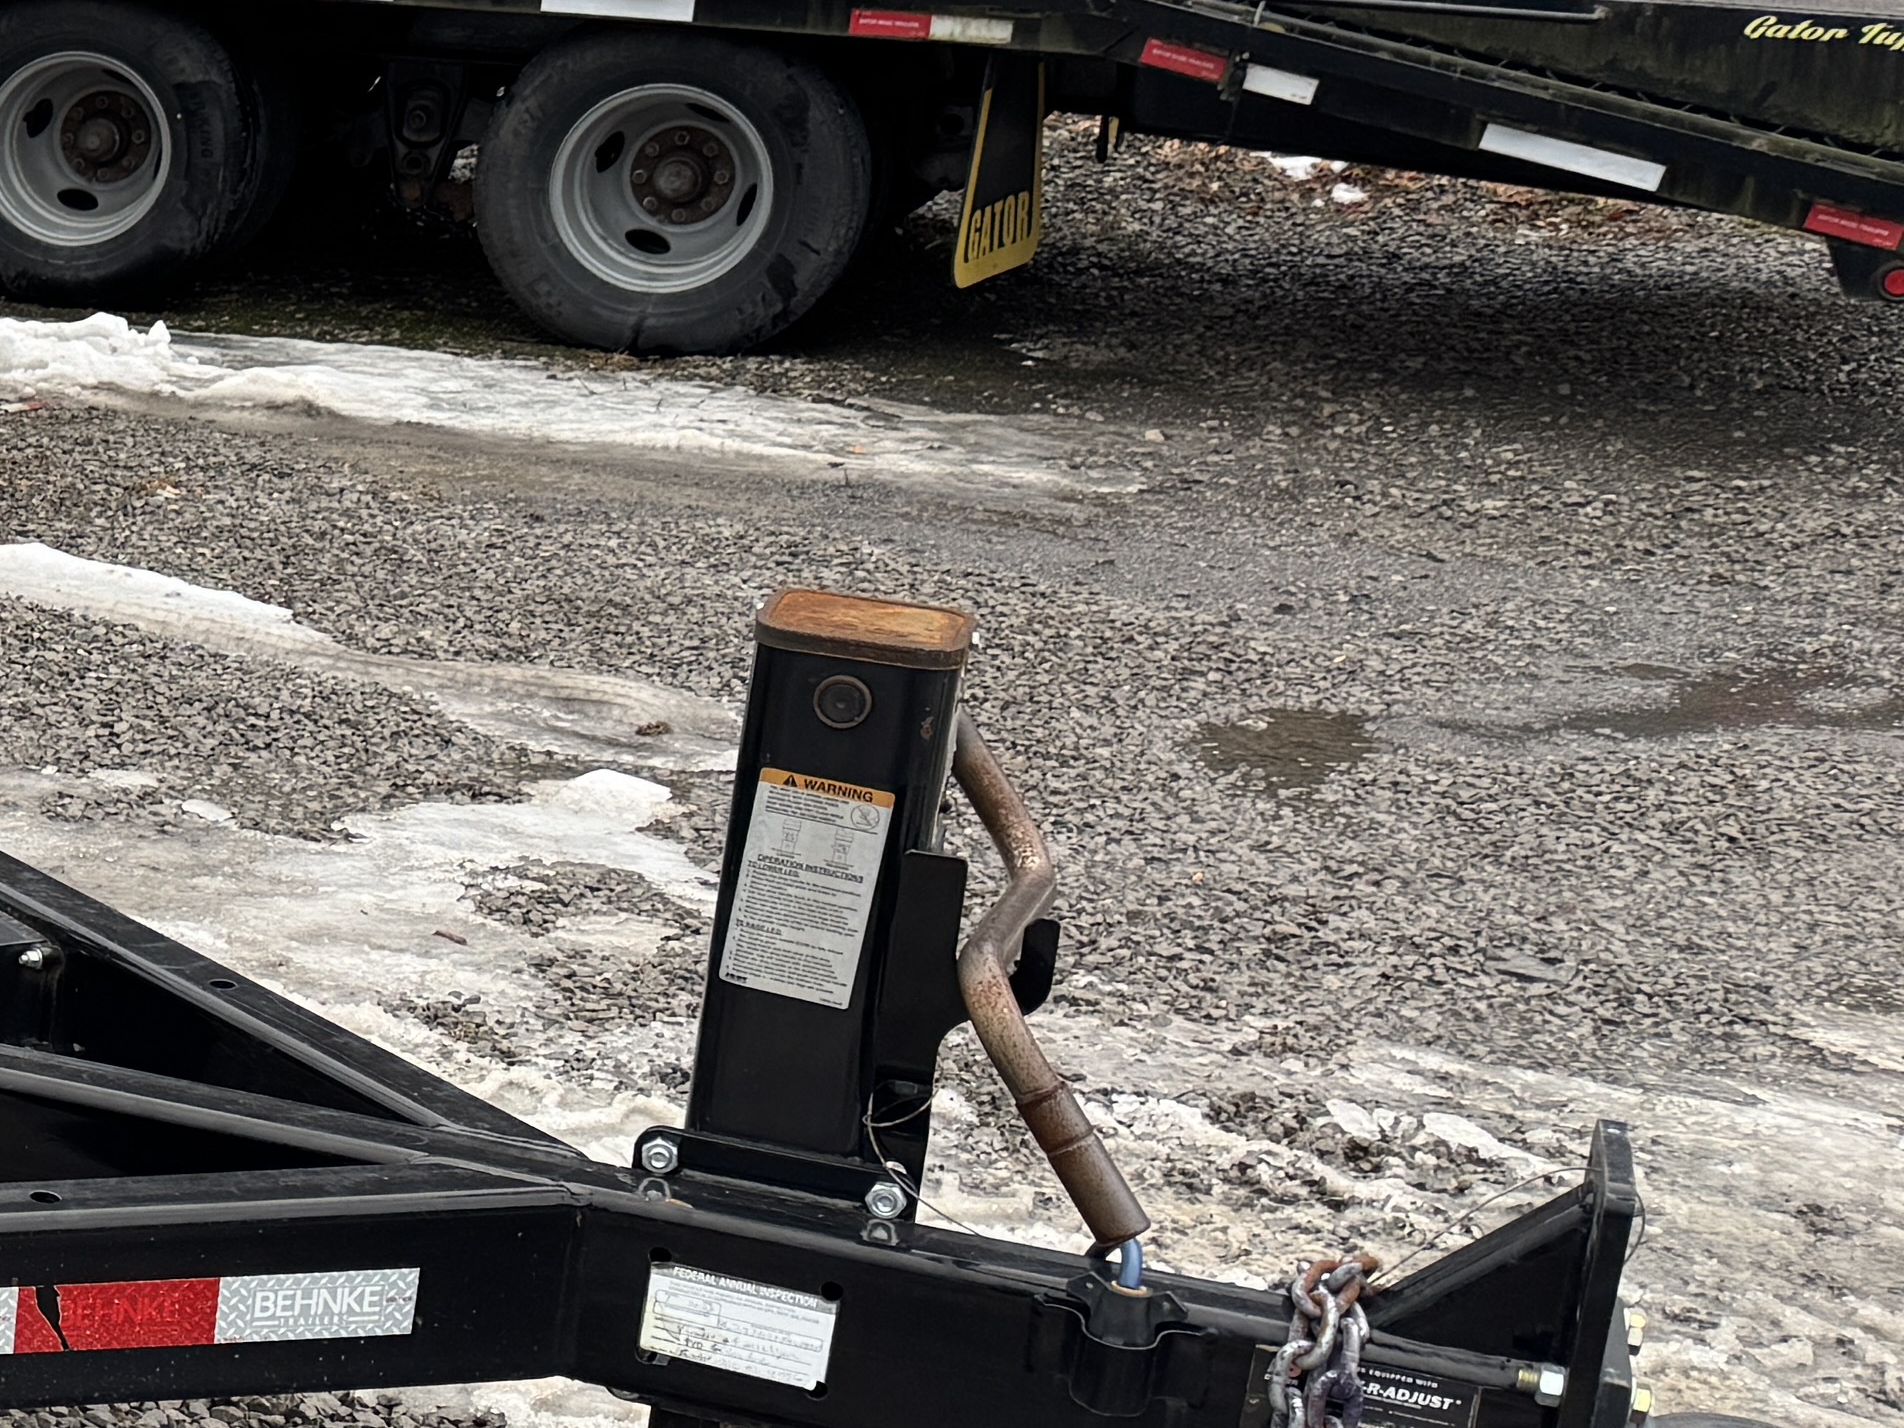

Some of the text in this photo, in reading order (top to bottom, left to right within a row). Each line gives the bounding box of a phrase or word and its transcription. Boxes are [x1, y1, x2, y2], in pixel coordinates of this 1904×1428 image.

[1743, 15, 1851, 42] Gator
[968, 190, 1030, 262] GATOR
[803, 778, 874, 803] WARNING
[254, 1285, 384, 1319] BEHNKE
[1360, 1380, 1454, 1410] -R-ADJUST
